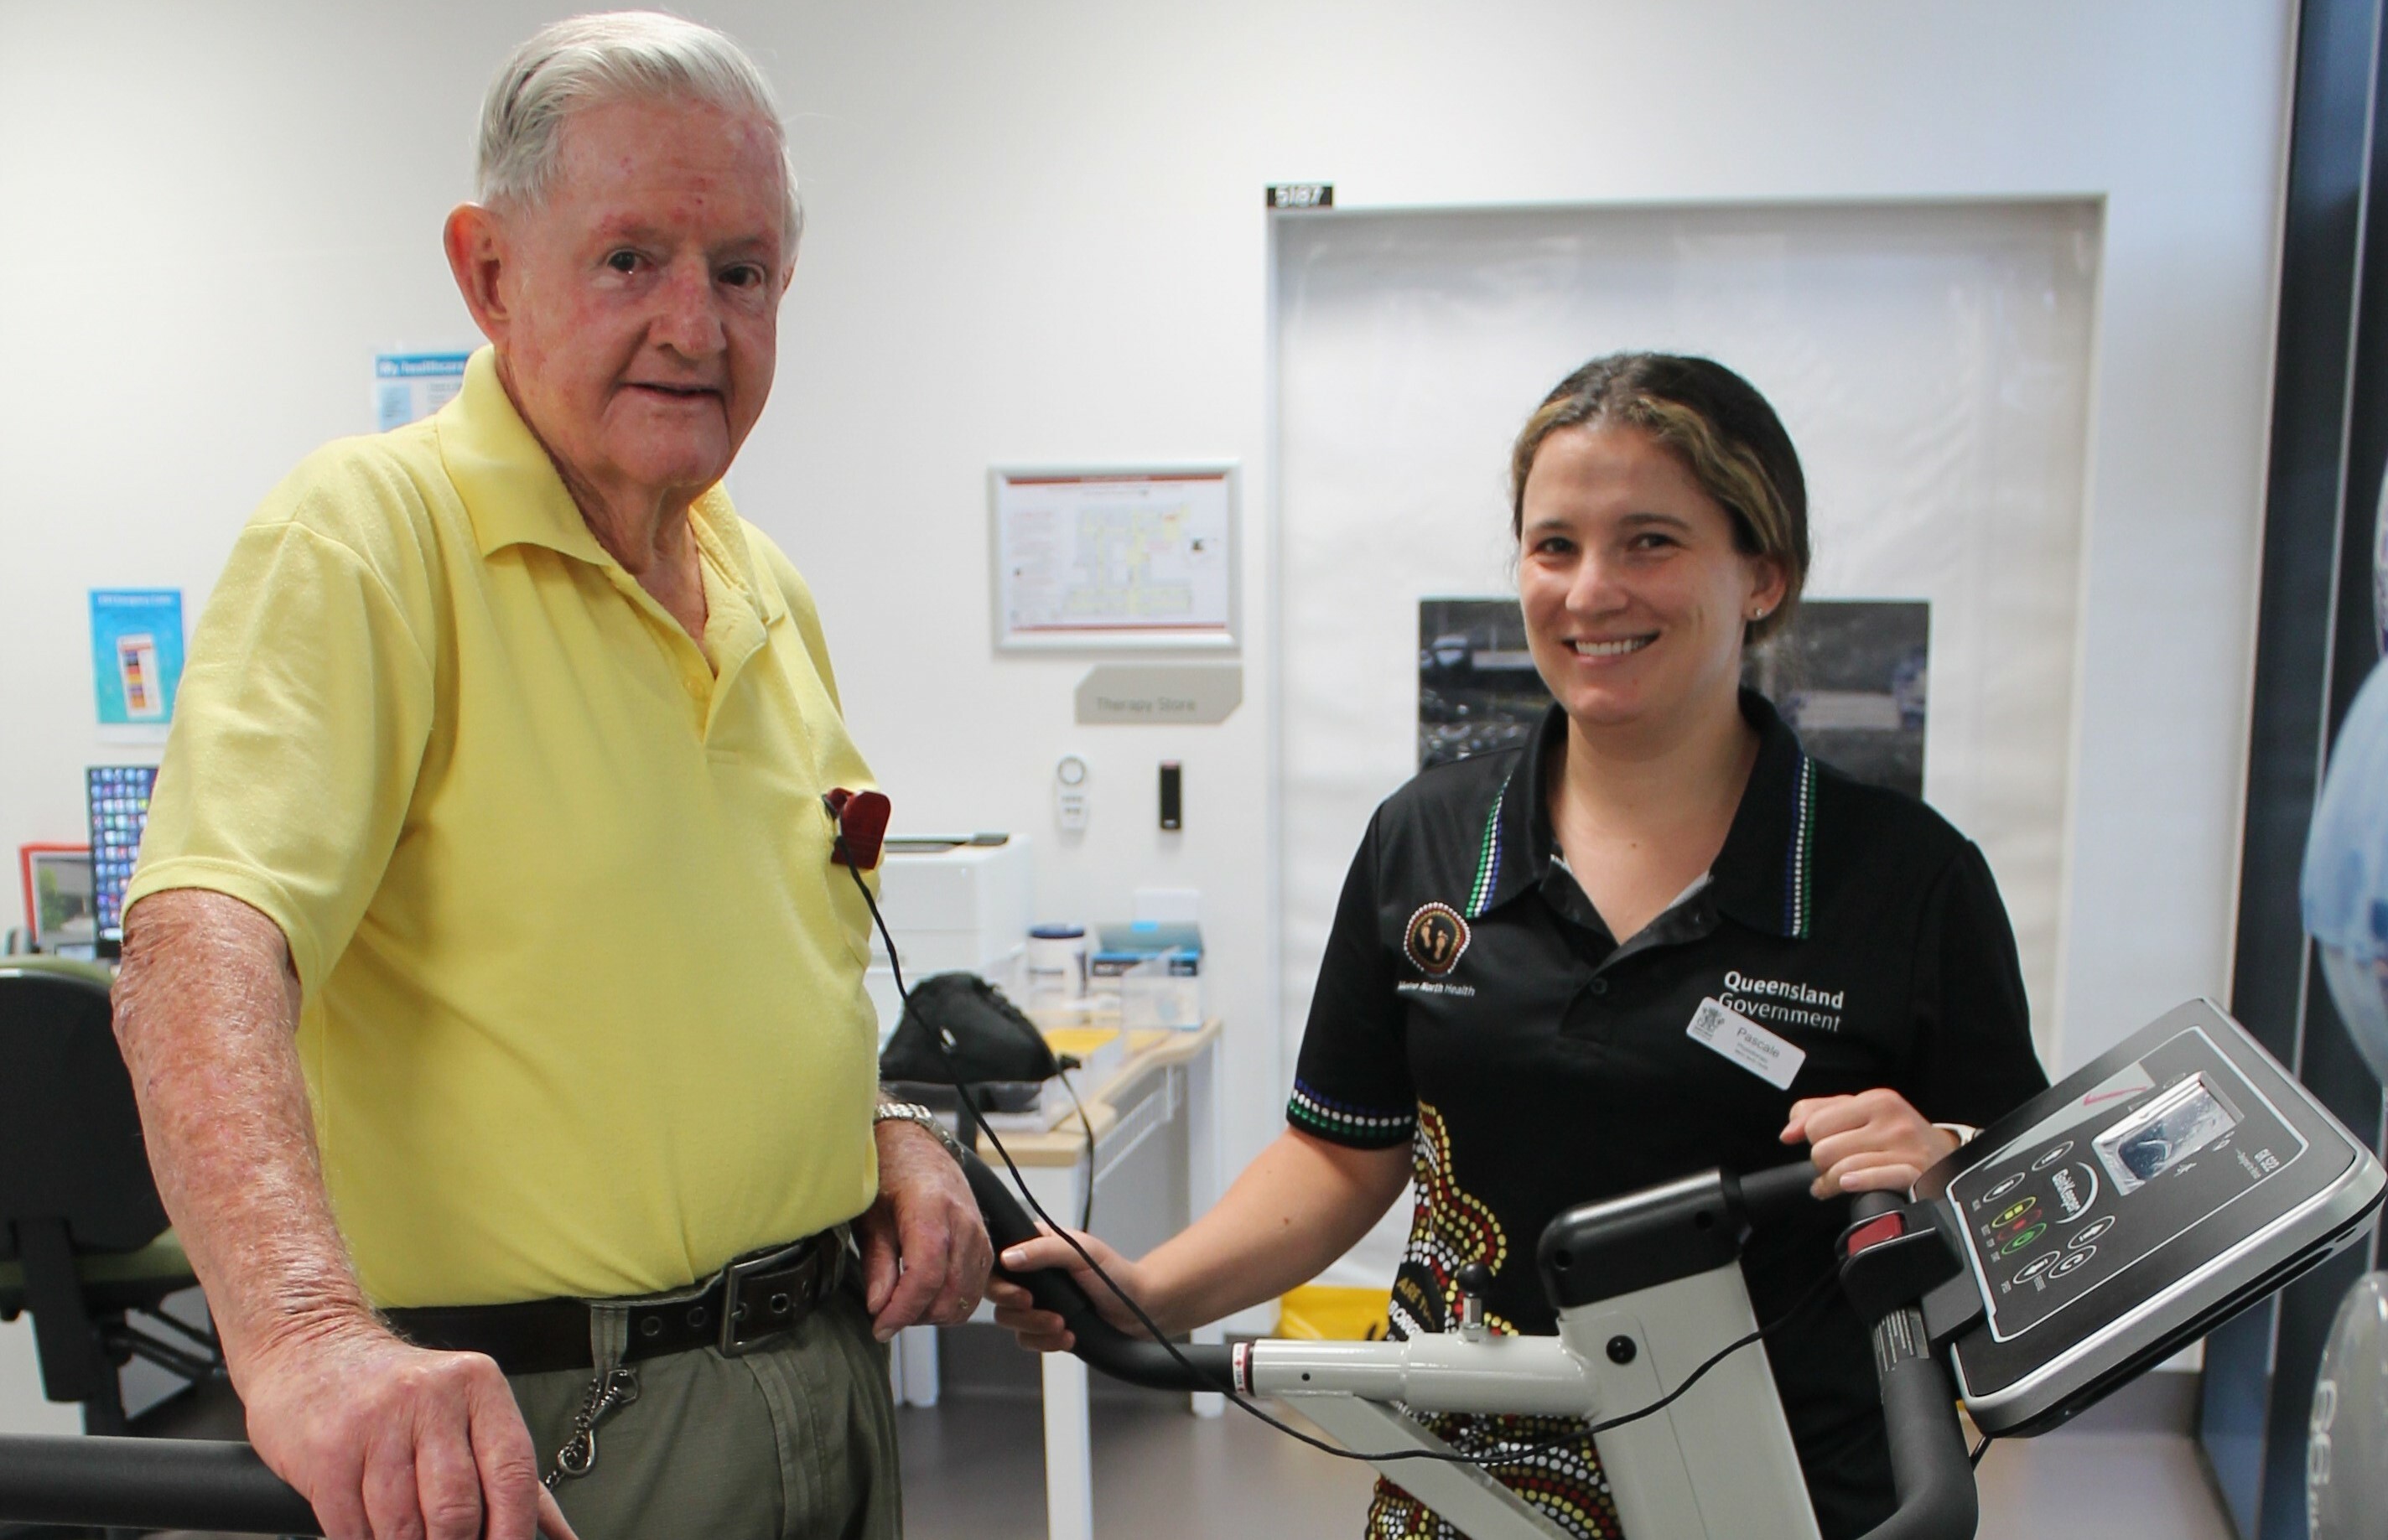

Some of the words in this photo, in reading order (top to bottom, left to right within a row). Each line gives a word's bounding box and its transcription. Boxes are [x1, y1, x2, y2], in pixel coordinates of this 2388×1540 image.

[1444, 983, 1476, 997] Health
[1724, 971, 1845, 1009] Queensland
[1720, 992, 1842, 1033] Government
[1736, 1027, 1780, 1058] Pascale
